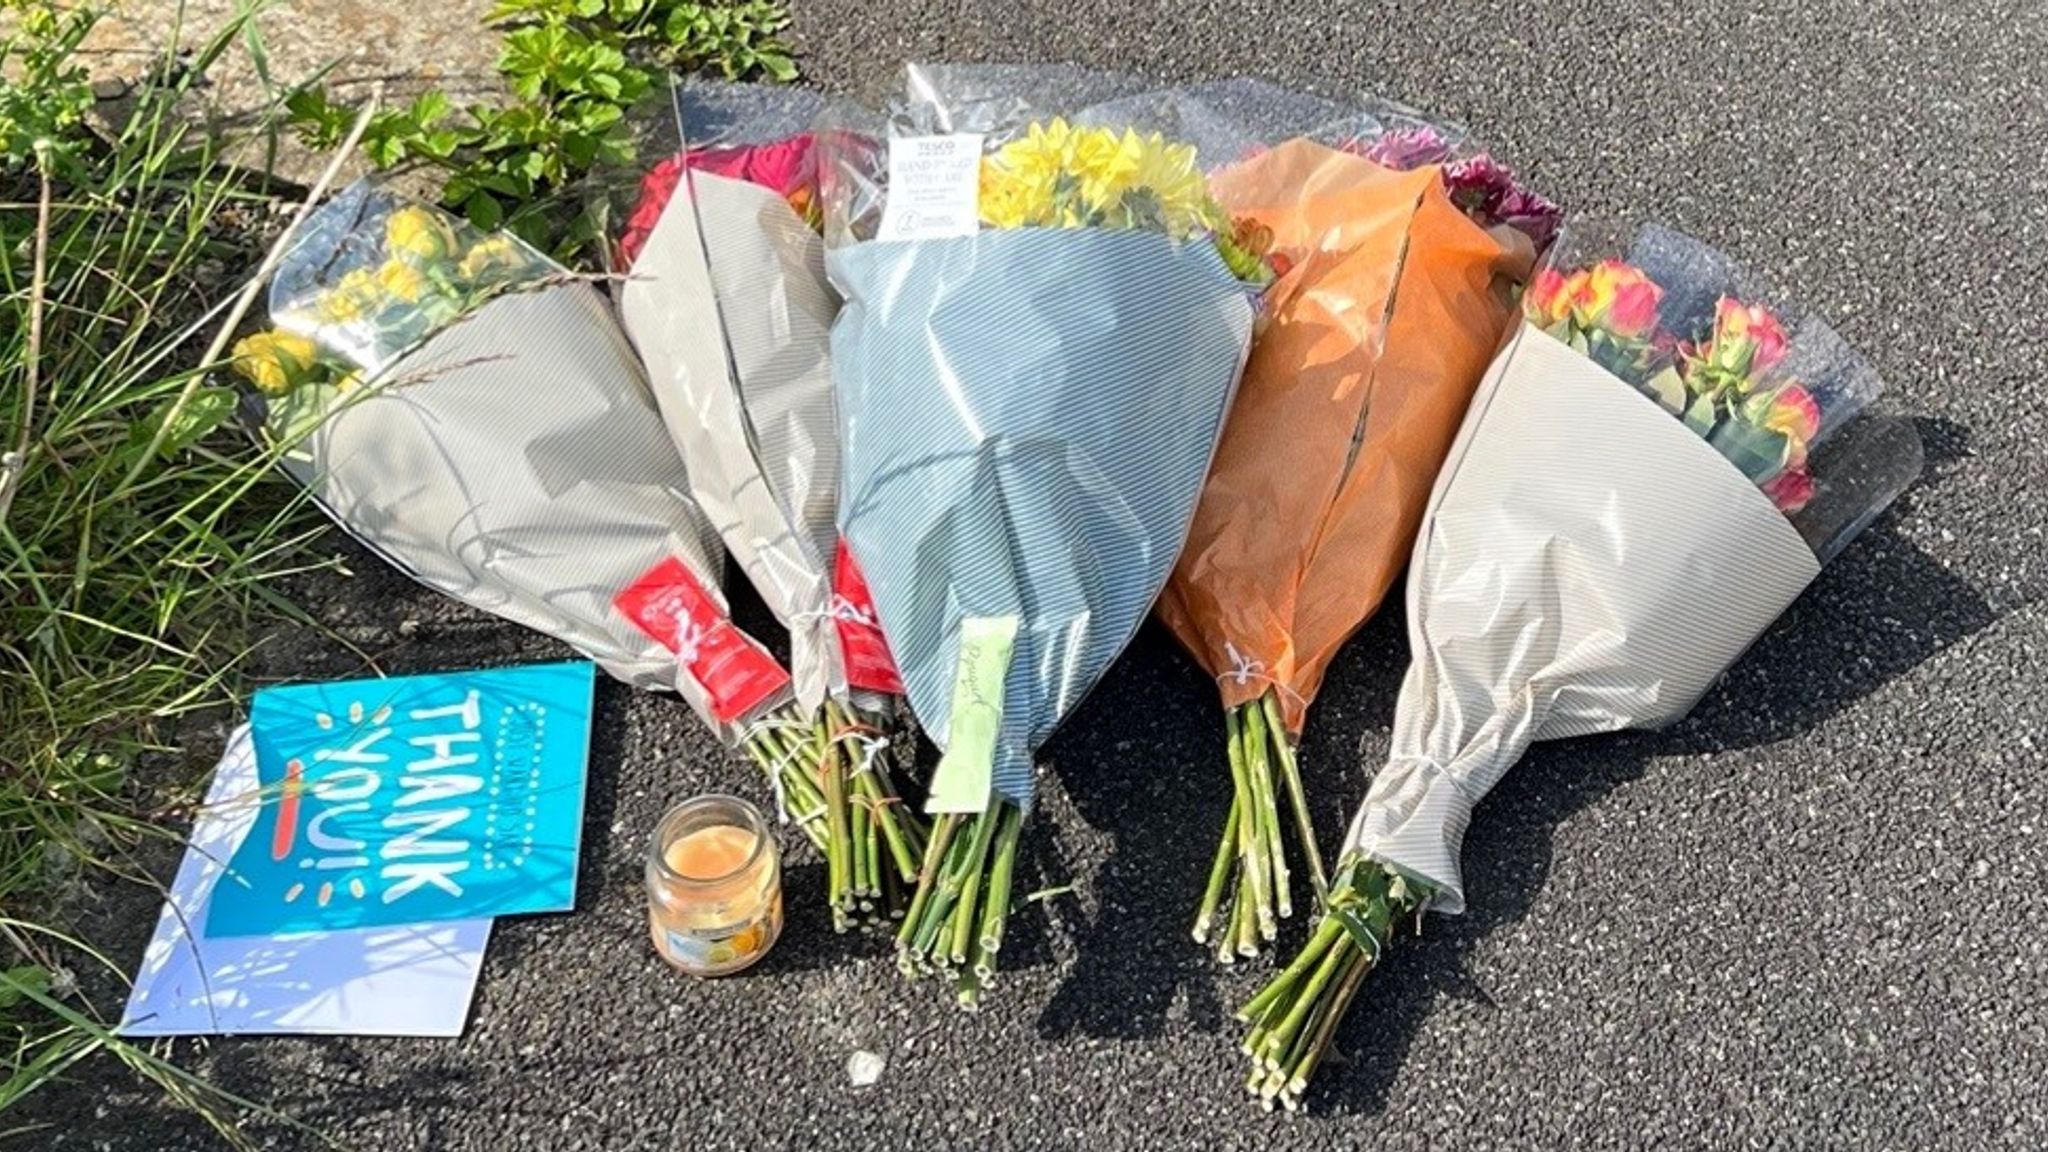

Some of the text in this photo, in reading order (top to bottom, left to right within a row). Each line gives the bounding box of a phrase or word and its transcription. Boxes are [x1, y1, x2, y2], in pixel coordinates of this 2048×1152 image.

[918, 140, 955, 150] TESCO
[300, 727, 392, 869] YOU!
[380, 689, 484, 903] THANK
